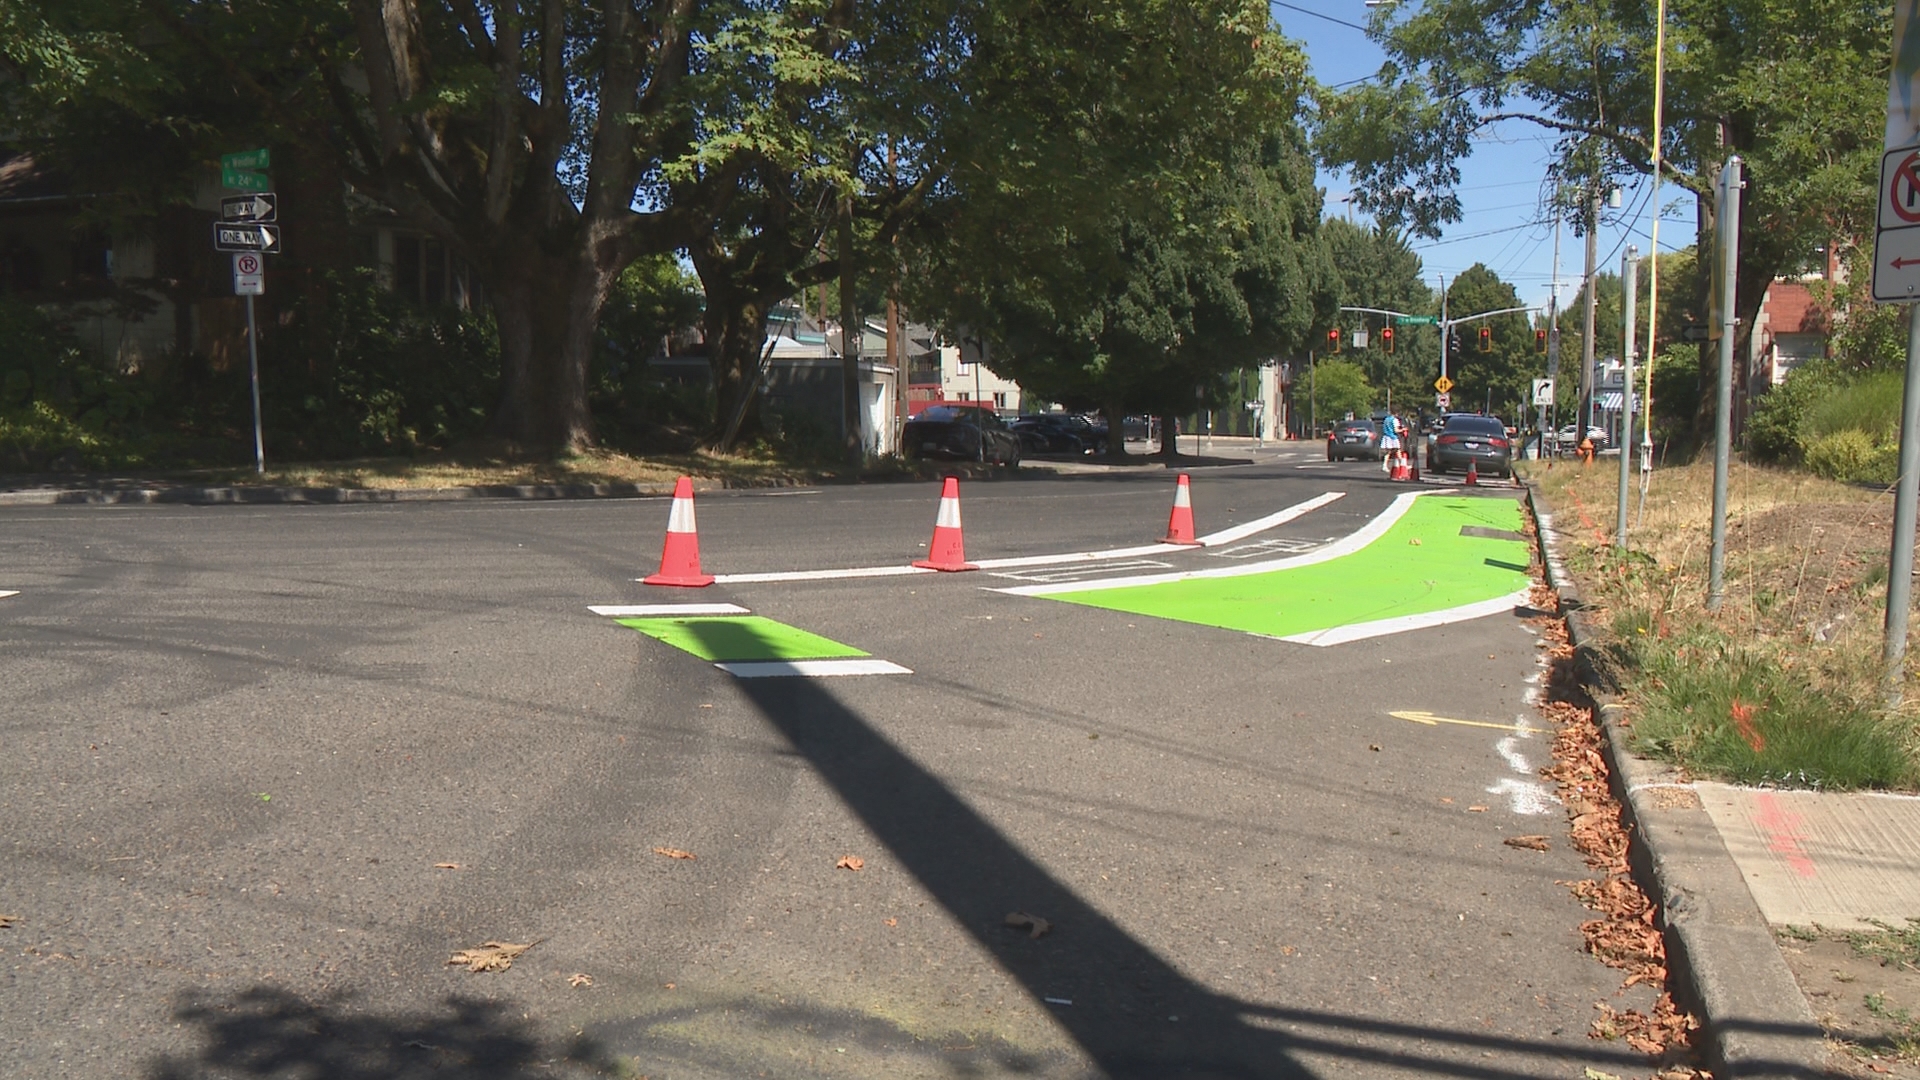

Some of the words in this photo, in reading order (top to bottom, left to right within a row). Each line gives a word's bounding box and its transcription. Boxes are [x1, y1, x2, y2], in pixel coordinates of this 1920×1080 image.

[238, 202, 254, 213] WAY
[222, 231, 240, 242] ONE
[243, 232, 261, 243] WAY
